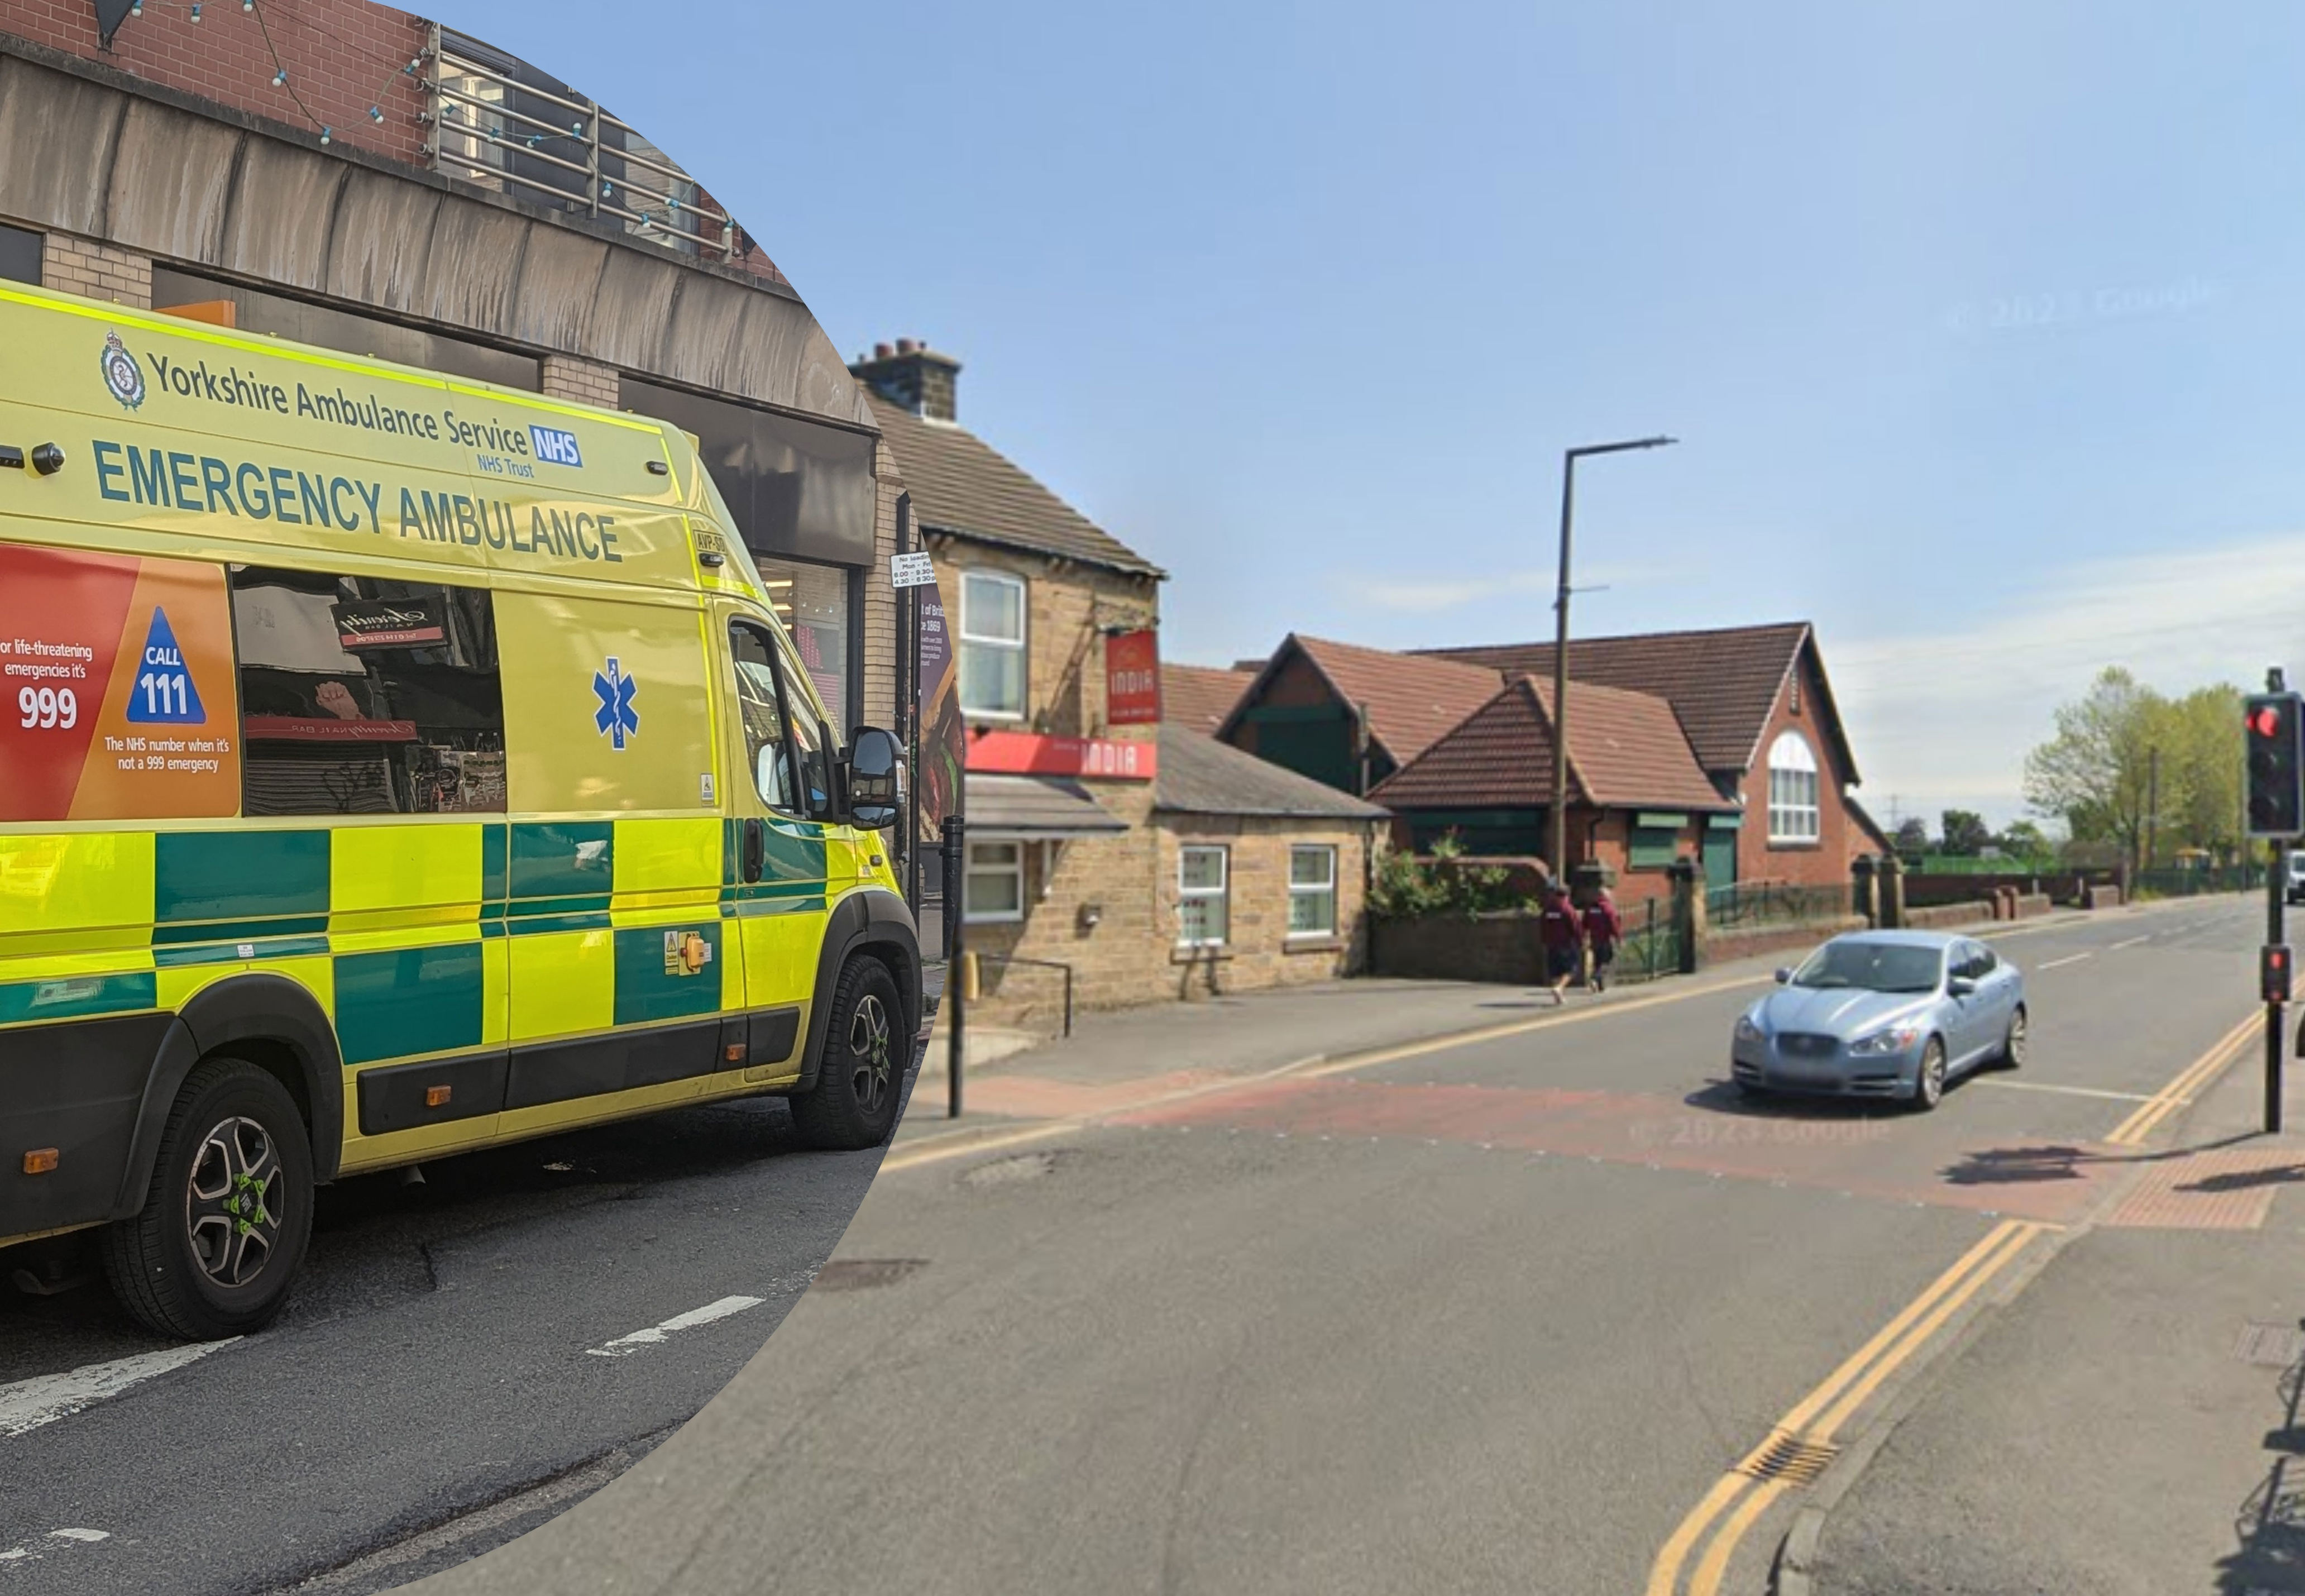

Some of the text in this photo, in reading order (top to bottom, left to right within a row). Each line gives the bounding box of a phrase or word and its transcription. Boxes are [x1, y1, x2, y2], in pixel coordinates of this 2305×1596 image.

[146, 352, 579, 465] Yorkshire Ambulance Service NHS
[477, 454, 534, 478] NHS Trust
[92, 439, 623, 562] EMERGENCY AMBULANCE
[0, 638, 93, 662] or life-threatening
[146, 647, 181, 666] CALL
[5, 662, 86, 680] emergencies it's
[1111, 670, 1154, 695] INDIA
[140, 673, 187, 714] 111
[18, 686, 76, 729] 999
[105, 735, 229, 752] The NHS number when it's
[118, 756, 218, 773] not a 999 emergency
